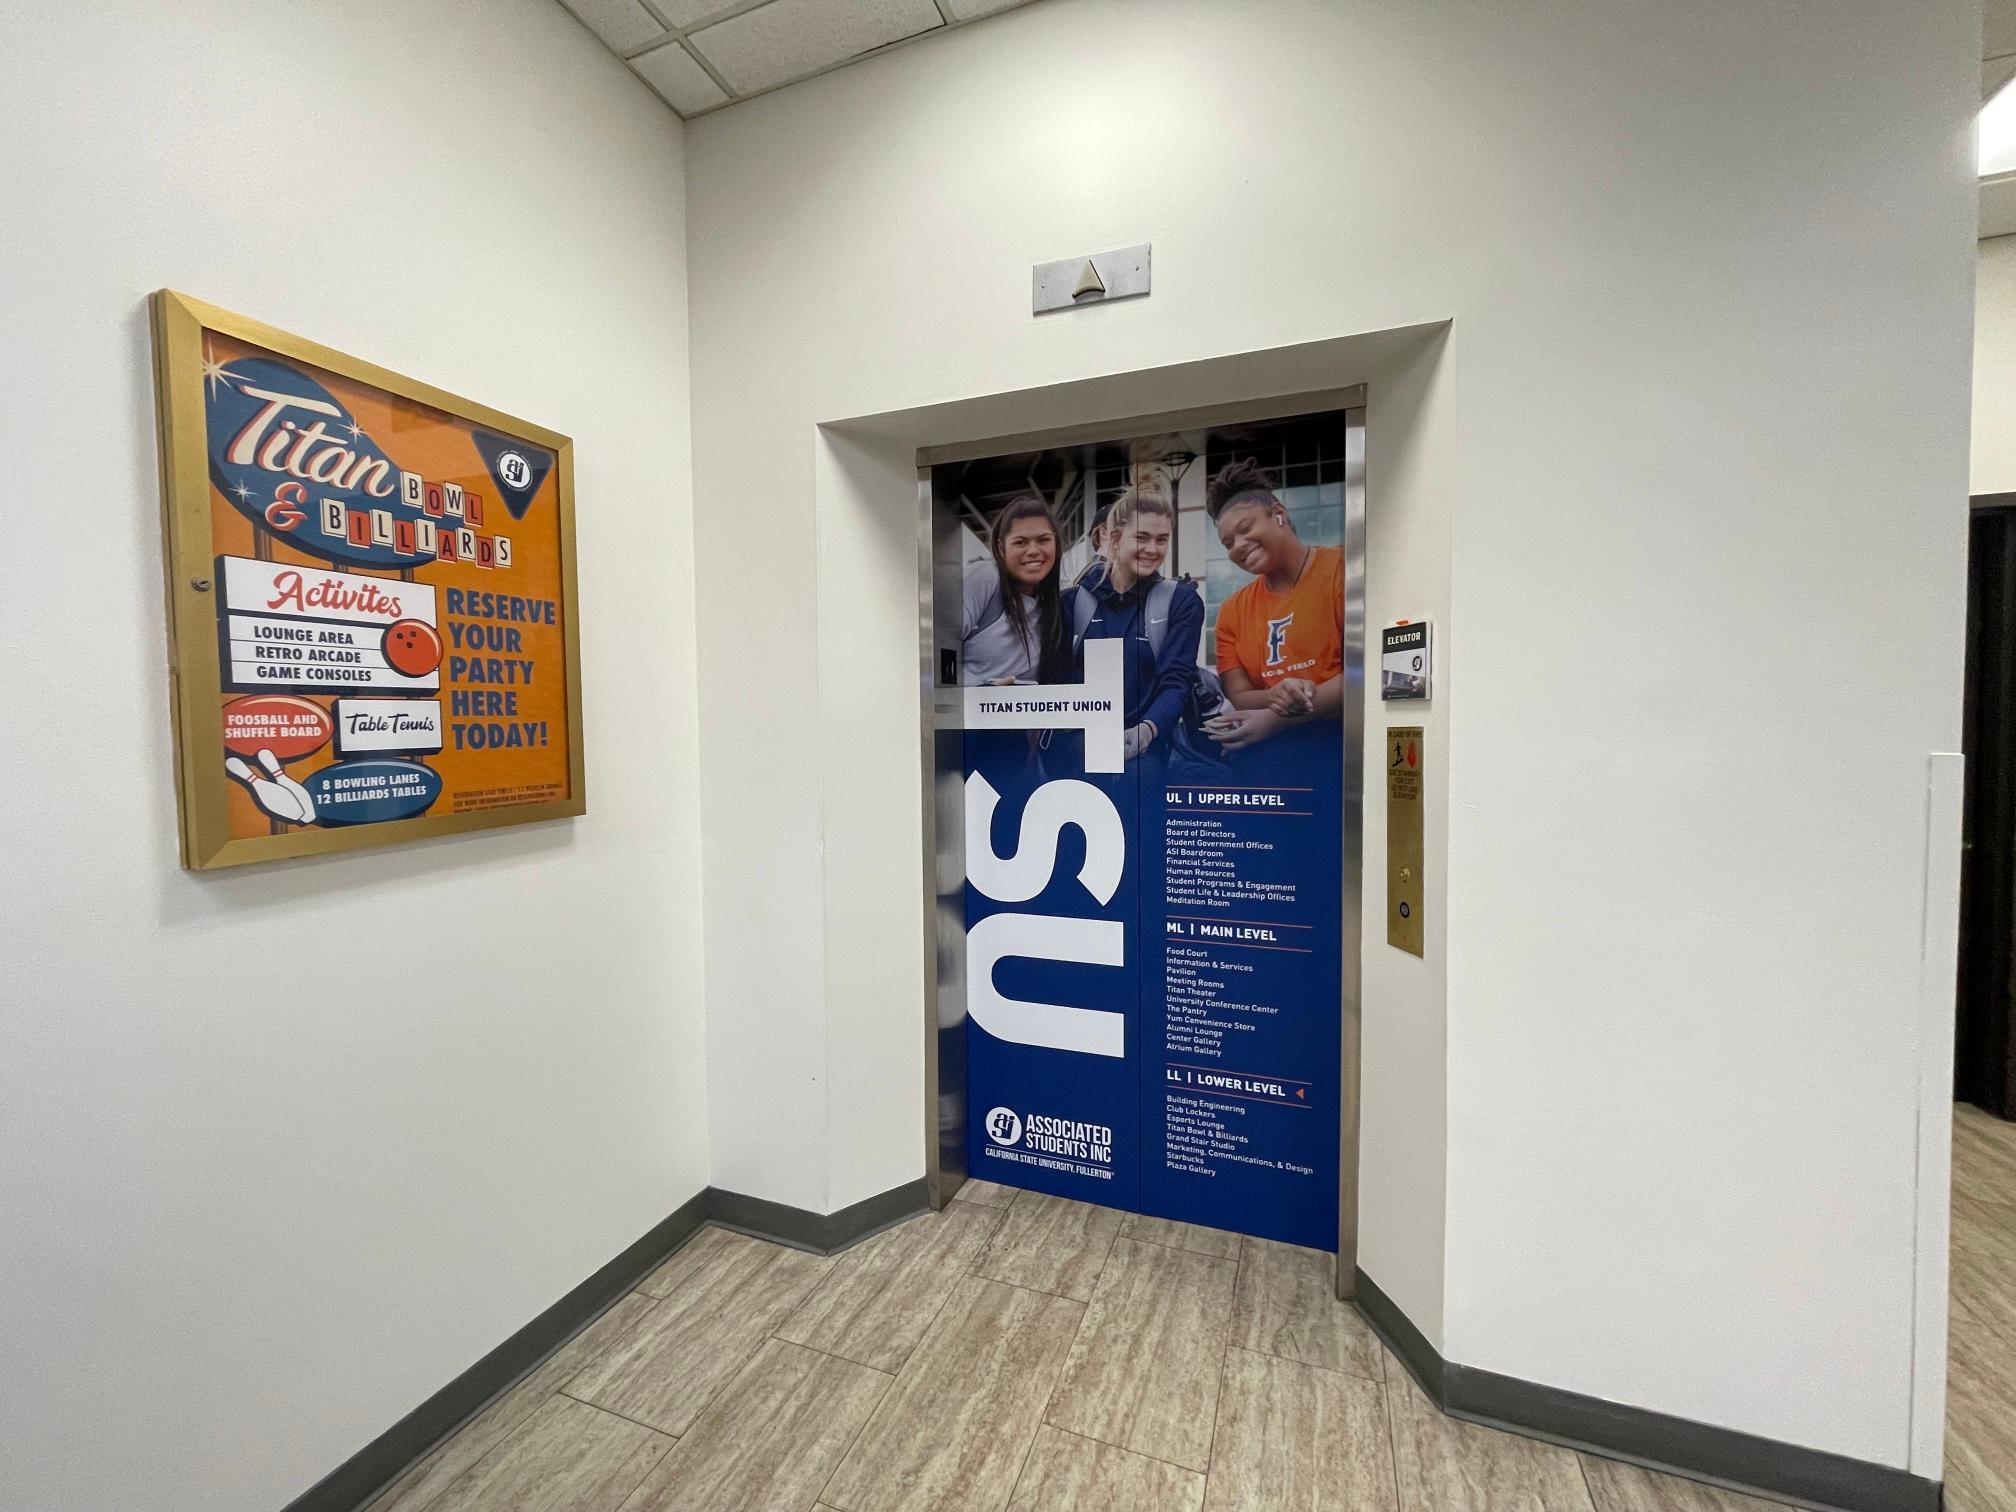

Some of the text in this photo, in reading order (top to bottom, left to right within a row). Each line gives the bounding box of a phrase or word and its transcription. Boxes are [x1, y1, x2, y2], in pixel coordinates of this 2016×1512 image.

[227, 386, 395, 497] Titan
[408, 477, 479, 521] BOWL
[265, 481, 508, 563] & BILLIARDS
[267, 571, 402, 618] Activites
[447, 588, 555, 625] RESERVE
[254, 626, 353, 644] LOUNGE AREA
[447, 622, 522, 653] YOUR
[1388, 632, 1421, 645] ELEVATOR
[256, 646, 361, 663] RETRO ARCADE
[257, 666, 371, 681] GAME CONSOLES
[450, 656, 534, 684] PARTY
[452, 690, 518, 716] HERE
[979, 701, 1111, 713] TITAN STUDENT UNION
[228, 714, 318, 725] FOOSBALL AND
[346, 714, 434, 734] Table Tennis
[225, 727, 321, 738] SHUFFLE BOARD
[452, 721, 547, 750] TODAY!
[322, 774, 420, 790] 8 BOWLING LANES
[317, 786, 426, 804] 12 BILLIARDS TABLES
[1166, 793, 1182, 803] UL
[1199, 794, 1240, 804] UPPER
[1244, 795, 1284, 806] LEVEL
[1166, 819, 1221, 827] Administration
[1200, 830, 1236, 838] Directors
[1197, 840, 1244, 848] Government
[1181, 849, 1223, 857] Boardroom
[1166, 858, 1200, 866] Financial
[1195, 869, 1235, 877] Resources
[1166, 877, 1195, 885] Student
[1197, 879, 1235, 888] Programs
[1246, 882, 1296, 891] Engagement
[1166, 887, 1195, 895] Student
[1222, 890, 1265, 900] Leadership
[1267, 893, 1295, 901] Offices
[1166, 896, 1229, 906] Meditation Room
[1167, 922, 1184, 933] ML
[1201, 925, 1232, 937] MAIN
[1236, 928, 1277, 941] LEVEL
[1167, 947, 1208, 957] Food Court
[1167, 957, 1210, 967] Information
[1220, 962, 1253, 971] Services
[1167, 967, 1196, 975] Pavilion
[1167, 976, 1224, 988] Meeting Rooms
[1167, 986, 1216, 997] Titan Theater
[1167, 995, 1279, 1014] University Conference Center
[1182, 1007, 1207, 1017] Pantry
[1167, 1014, 1255, 1031] Yum Convenience Store
[1167, 1024, 1222, 1037] Alumni Lounge
[1167, 1034, 1221, 1047] Center Gallery
[1167, 1043, 1221, 1057] Atrium Gallery
[1167, 1070, 1181, 1081] LL
[1198, 1074, 1242, 1089] LOWER
[1245, 1081, 1285, 1096] LEVEL
[1167, 1095, 1245, 1115] Building Engineering
[1167, 1105, 1215, 1118] Club Lockers
[1026, 1114, 1111, 1145] ASSOCIATED
[1167, 1114, 1224, 1130] Esports Lounge
[1167, 1124, 1185, 1132] Titan
[1188, 1127, 1205, 1136] Bowl
[1216, 1132, 1248, 1143] Billiards
[1026, 1133, 1111, 1163] STUDENTS INC
[1167, 1133, 1235, 1151] Grand Stair Studio
[986, 1148, 1019, 1161] CALIFORNIA
[1020, 1155, 1037, 1166] STATE
[1039, 1158, 1075, 1173] UNIVERSITY,
[1167, 1152, 1204, 1164] Starbucks
[1209, 1150, 1275, 1168] Communications,
[1286, 1163, 1313, 1174] Design
[1167, 1161, 1216, 1177] Plaza Gallery
